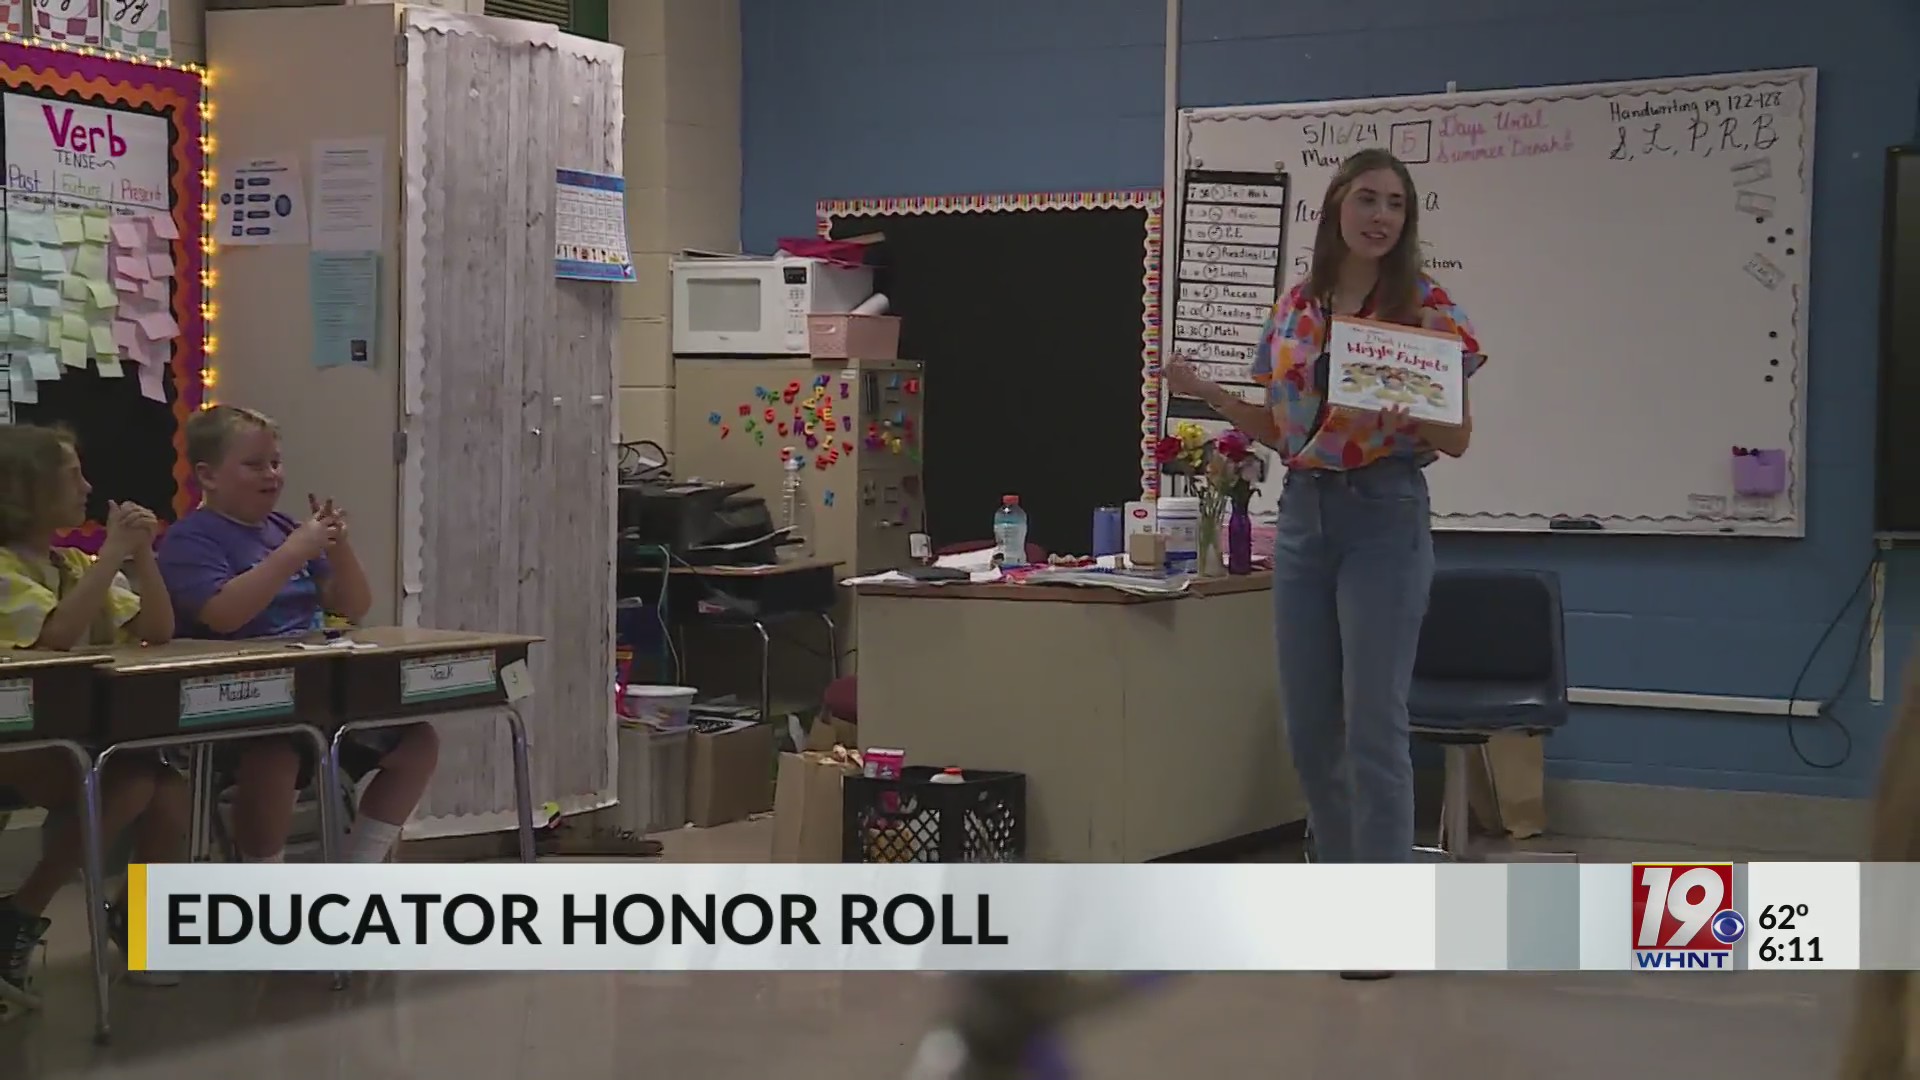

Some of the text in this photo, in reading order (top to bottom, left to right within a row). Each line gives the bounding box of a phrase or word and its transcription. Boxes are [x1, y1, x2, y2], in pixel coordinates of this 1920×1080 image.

[1609, 100, 1699, 122] Handwriting
[41, 104, 127, 157] Verb
[1303, 121, 1378, 146] 5/16/24
[1439, 109, 1549, 145] Days Until
[1752, 113, 1780, 150] B
[1400, 130, 1417, 154] 5
[1436, 140, 1504, 163] Summer
[53, 149, 98, 170] TENSE
[1302, 148, 1341, 169] May
[9, 164, 41, 193] Past
[121, 177, 163, 202] Present
[1214, 325, 1239, 336] Math
[430, 663, 454, 681] Jack
[218, 680, 261, 701] Maddie
